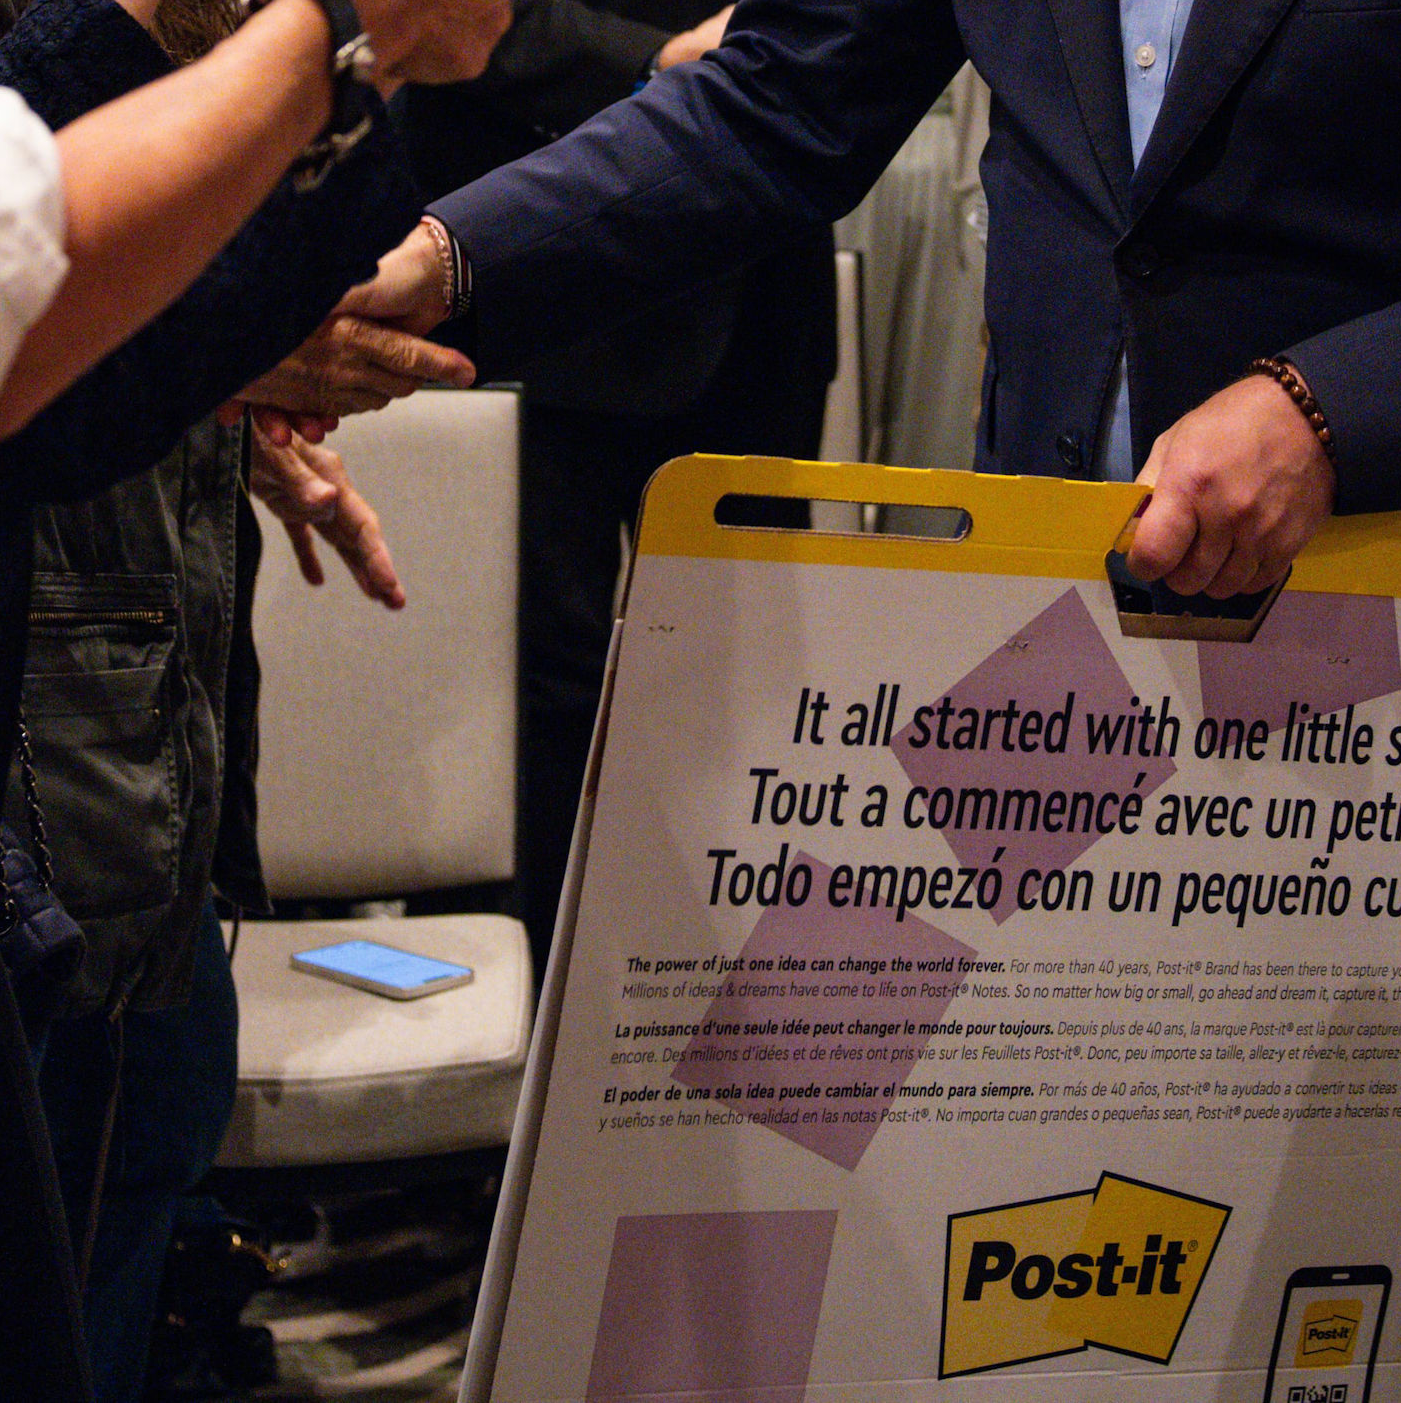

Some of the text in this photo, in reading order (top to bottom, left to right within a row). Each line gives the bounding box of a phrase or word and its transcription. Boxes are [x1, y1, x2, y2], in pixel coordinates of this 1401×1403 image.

[793, 687, 829, 745] It
[841, 683, 900, 747] all
[908, 691, 1075, 753] started
[1086, 695, 1181, 758] with
[1194, 716, 1269, 761] one
[1281, 701, 1374, 765] little
[749, 768, 849, 827] Tout
[860, 783, 889, 828] a
[903, 772, 1147, 835] commencé
[1155, 793, 1253, 839] avec
[1265, 796, 1317, 839] un
[705, 843, 813, 907] Todo
[828, 847, 1007, 922] empezó
[1016, 867, 1095, 911] con
[1108, 869, 1162, 912] un
[1171, 856, 1352, 928] pequeño
[627, 956, 652, 972] The
[654, 960, 699, 974] power
[702, 955, 718, 971] of
[718, 955, 745, 974] just
[748, 959, 774, 971] one
[777, 955, 807, 971] idea
[810, 960, 834, 972] can
[838, 956, 887, 974] change
[891, 956, 913, 972] the
[916, 957, 955, 972] world
[957, 957, 1006, 973] forever.
[1010, 959, 1030, 973] For
[1033, 962, 1065, 974] more
[1069, 960, 1095, 973] than
[1099, 960, 1114, 974] 40
[1117, 964, 1151, 977] years,
[1205, 961, 1240, 975] Brand
[1243, 962, 1262, 975] has
[1266, 962, 1294, 976] been
[1298, 962, 1327, 976] there
[1331, 964, 1343, 976] to
[622, 983, 669, 998] Millions
[673, 982, 687, 998] of
[689, 983, 722, 997] ideas
[726, 983, 735, 998] &
[738, 984, 786, 997] dreams
[789, 982, 820, 997] have
[823, 985, 859, 997] come
[862, 985, 876, 997] to
[879, 981, 898, 997] life
[901, 986, 917, 997] on
[972, 985, 1010, 998] Notes.
[1014, 984, 1030, 998] So
[1033, 987, 1049, 998] no
[1052, 986, 1092, 998] matter
[1095, 984, 1121, 999] how
[1124, 985, 1144, 1002] big
[1146, 988, 1160, 999] or
[1162, 985, 1194, 1001] small,
[1198, 988, 1215, 1003] go
[1217, 986, 1254, 1000] ahead
[1255, 986, 1278, 1000] and
[615, 1024, 631, 1038] La
[633, 1021, 700, 1040] puissance
[743, 1020, 779, 1035] seule
[781, 1019, 811, 1035] idée
[812, 1022, 844, 1037] peut
[847, 1019, 902, 1037] changer
[903, 1019, 916, 1035] le
[918, 1020, 963, 1035] monde
[965, 1024, 997, 1037] pour
[999, 1020, 1054, 1037] toujours.
[1057, 1021, 1098, 1036] Depuis
[1101, 1021, 1125, 1037] plus
[1128, 1021, 1144, 1035] de
[1146, 1021, 1162, 1035] 40
[1164, 1024, 1186, 1037] ans,
[1190, 1021, 1201, 1035] la
[1203, 1025, 1247, 1037] marque
[1296, 1025, 1313, 1036] est
[610, 1051, 657, 1064] encore.
[662, 1048, 687, 1063] Des
[690, 1046, 739, 1061] millions
[793, 1048, 806, 1061] et
[809, 1045, 826, 1060] de
[829, 1045, 863, 1060] rêves
[866, 1048, 888, 1060] ont
[890, 1047, 914, 1063] pris
[918, 1047, 936, 1060] vie
[939, 1049, 959, 1060] sur
[961, 1046, 978, 1060] les
[982, 1046, 1031, 1060] Feuillets
[1087, 1046, 1121, 1062] Donc,
[1124, 1049, 1148, 1062] peu
[1151, 1049, 1197, 1061] importe
[1199, 1049, 1212, 1060] sa
[1216, 1046, 1245, 1061] taille,
[1249, 1046, 1286, 1062] allez-y
[603, 1087, 617, 1104] El
[619, 1086, 661, 1105] poder
[664, 1085, 681, 1101] de
[686, 1088, 711, 1100] una
[714, 1084, 742, 1100] sola
[746, 1083, 775, 1099] idea
[778, 1083, 821, 1101] puede
[825, 1082, 879, 1098] cambiar
[882, 1082, 896, 1098] el
[899, 1082, 944, 1097] mundo
[947, 1086, 977, 1100] para
[980, 1082, 1034, 1099] siempre.
[1039, 1082, 1059, 1096] Por
[1063, 1081, 1087, 1096] más
[1091, 1082, 1107, 1096] de
[1111, 1082, 1127, 1096] 40
[1130, 1081, 1160, 1098] años,
[1214, 1081, 1228, 1096] ha
[1231, 1082, 1281, 1098] ayudado
[598, 1118, 608, 1132] y
[611, 1113, 655, 1128] sueños
[659, 1115, 674, 1127] se
[677, 1111, 701, 1126] han
[704, 1111, 745, 1125] hecho
[748, 1110, 799, 1124] realidad
[802, 1111, 818, 1123] en
[822, 1109, 838, 1123] las
[842, 1111, 877, 1123] notas
[936, 1109, 954, 1122] No
[957, 1110, 1005, 1124] importa
[1008, 1110, 1037, 1122] cuan
[1040, 1107, 1088, 1124] grandes
[1091, 1109, 1100, 1121] o
[1102, 1106, 1160, 1122] pequeñas
[1163, 1109, 1192, 1122] sean,
[1243, 1106, 1280, 1121] puede
